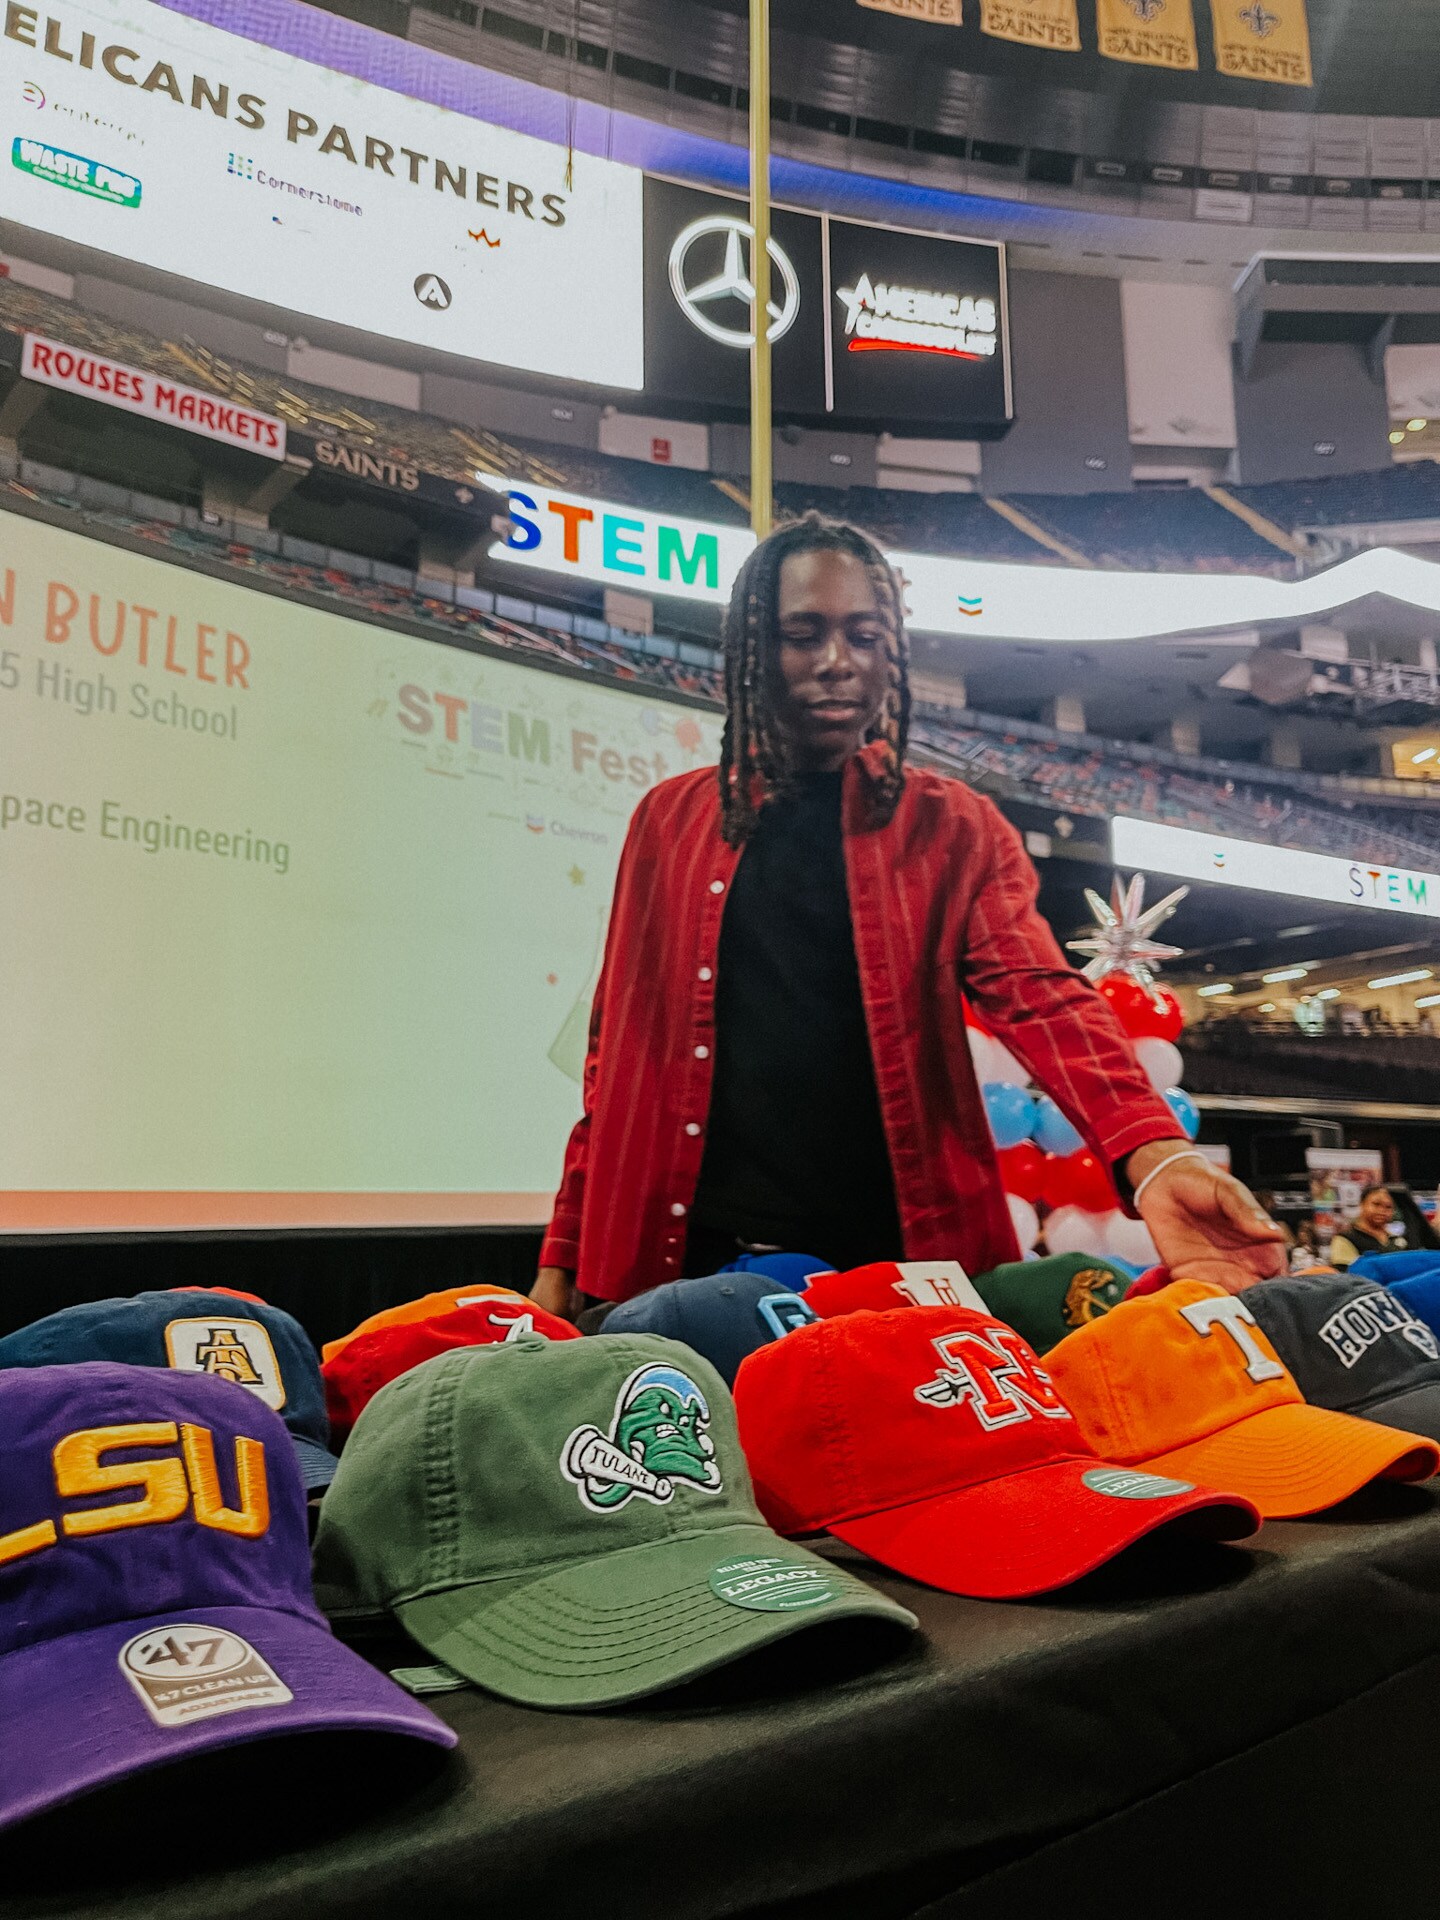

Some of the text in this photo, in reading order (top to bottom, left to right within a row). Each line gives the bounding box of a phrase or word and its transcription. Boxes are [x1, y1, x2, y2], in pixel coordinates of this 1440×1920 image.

[4, 0, 568, 228] ELICANS PARTNERS
[256, 169, 364, 217] Cornerstone
[32, 343, 279, 448] ROUSES MARKETS
[314, 440, 420, 491] SAINTS
[507, 490, 719, 589] STEM
[45, 581, 250, 689] BUTLER
[37, 658, 117, 716] High
[129, 682, 237, 740] School
[398, 683, 668, 787] STEM Fest
[101, 800, 289, 874] Engineering
[1348, 866, 1428, 906] STEM
[1180, 1296, 1284, 1382] T
[0, 1421, 270, 1565] SU
[721, 1570, 823, 1597] LEGACY
[182, 1677, 245, 1697] CLEAN
[244, 1673, 270, 1684] UP
